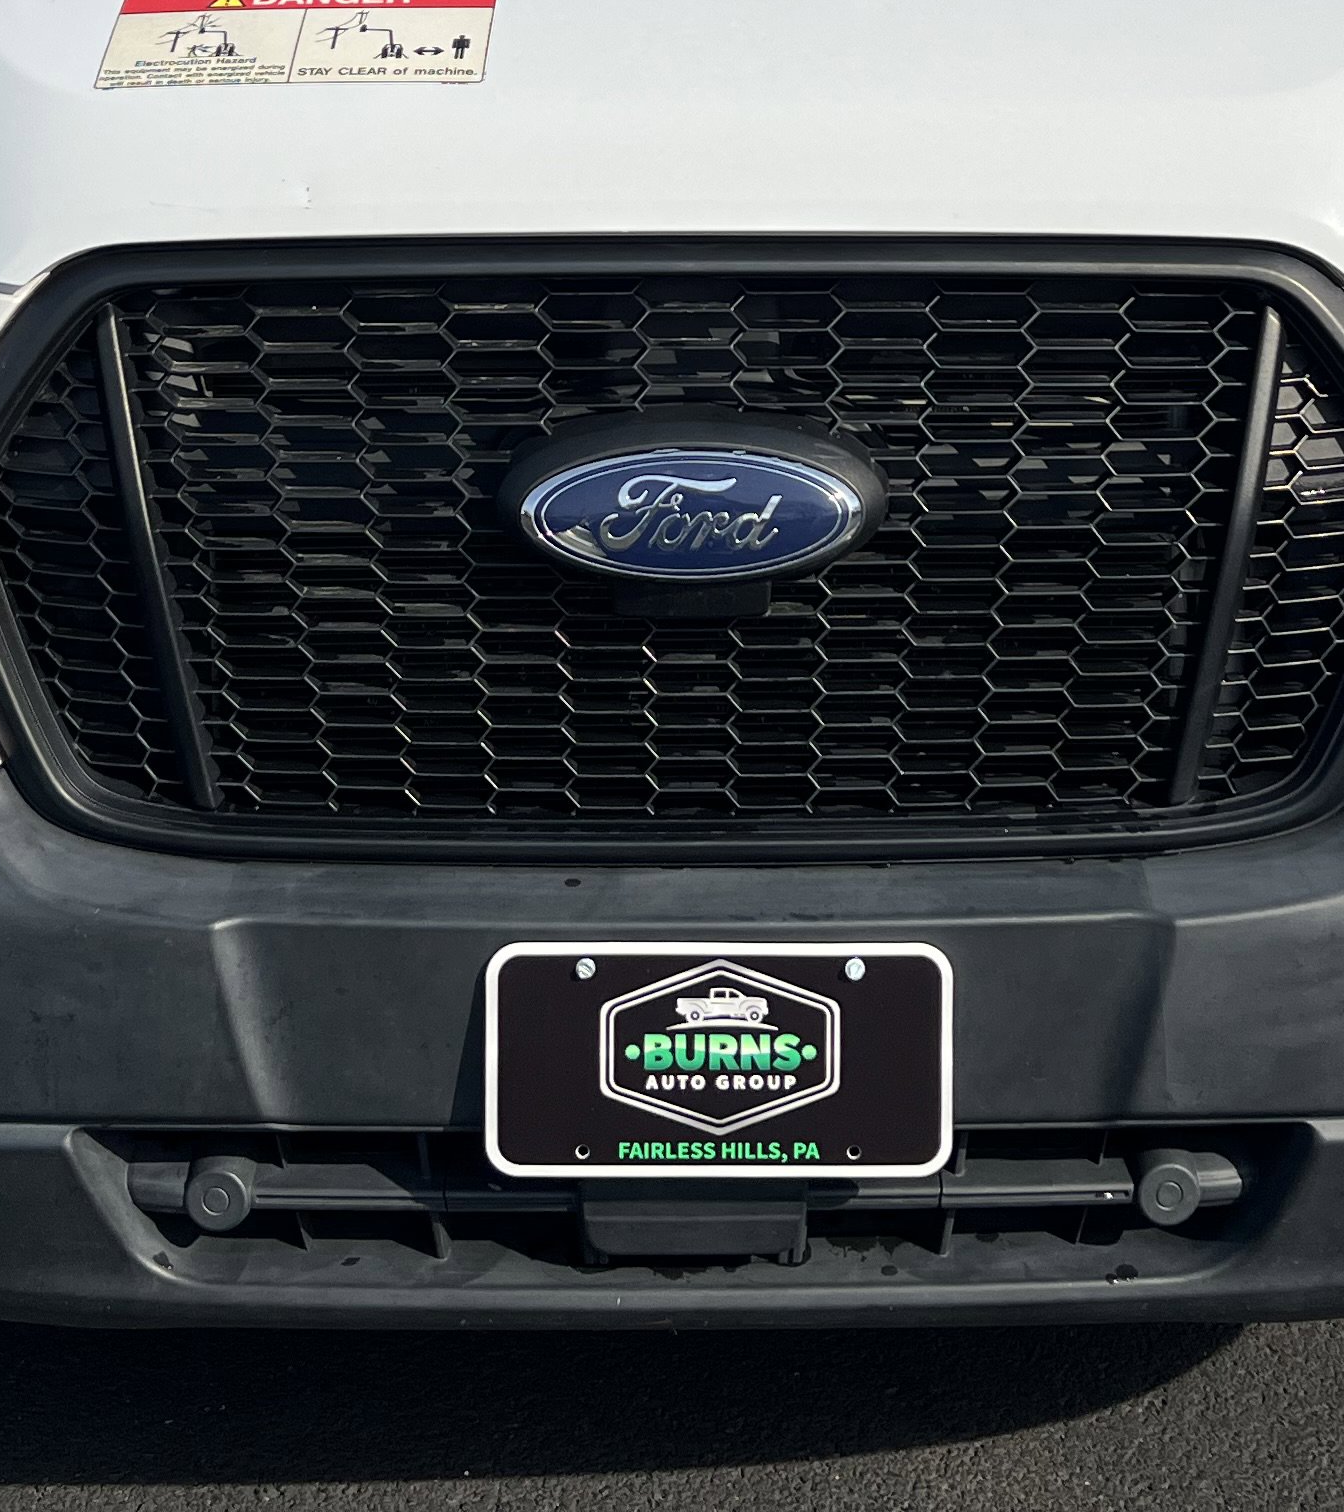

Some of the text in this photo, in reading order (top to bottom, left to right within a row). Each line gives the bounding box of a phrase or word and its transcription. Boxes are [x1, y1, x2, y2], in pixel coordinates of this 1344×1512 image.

[135, 56, 257, 68] Electrocution Hazard
[296, 67, 478, 77] STAY CLEAR of machine.
[599, 474, 784, 553] Ford
[643, 1033, 802, 1072] BURNS
[645, 1075, 798, 1091] AUTO GROUP
[618, 1141, 820, 1163] FAIRLESS HILLS, PA
